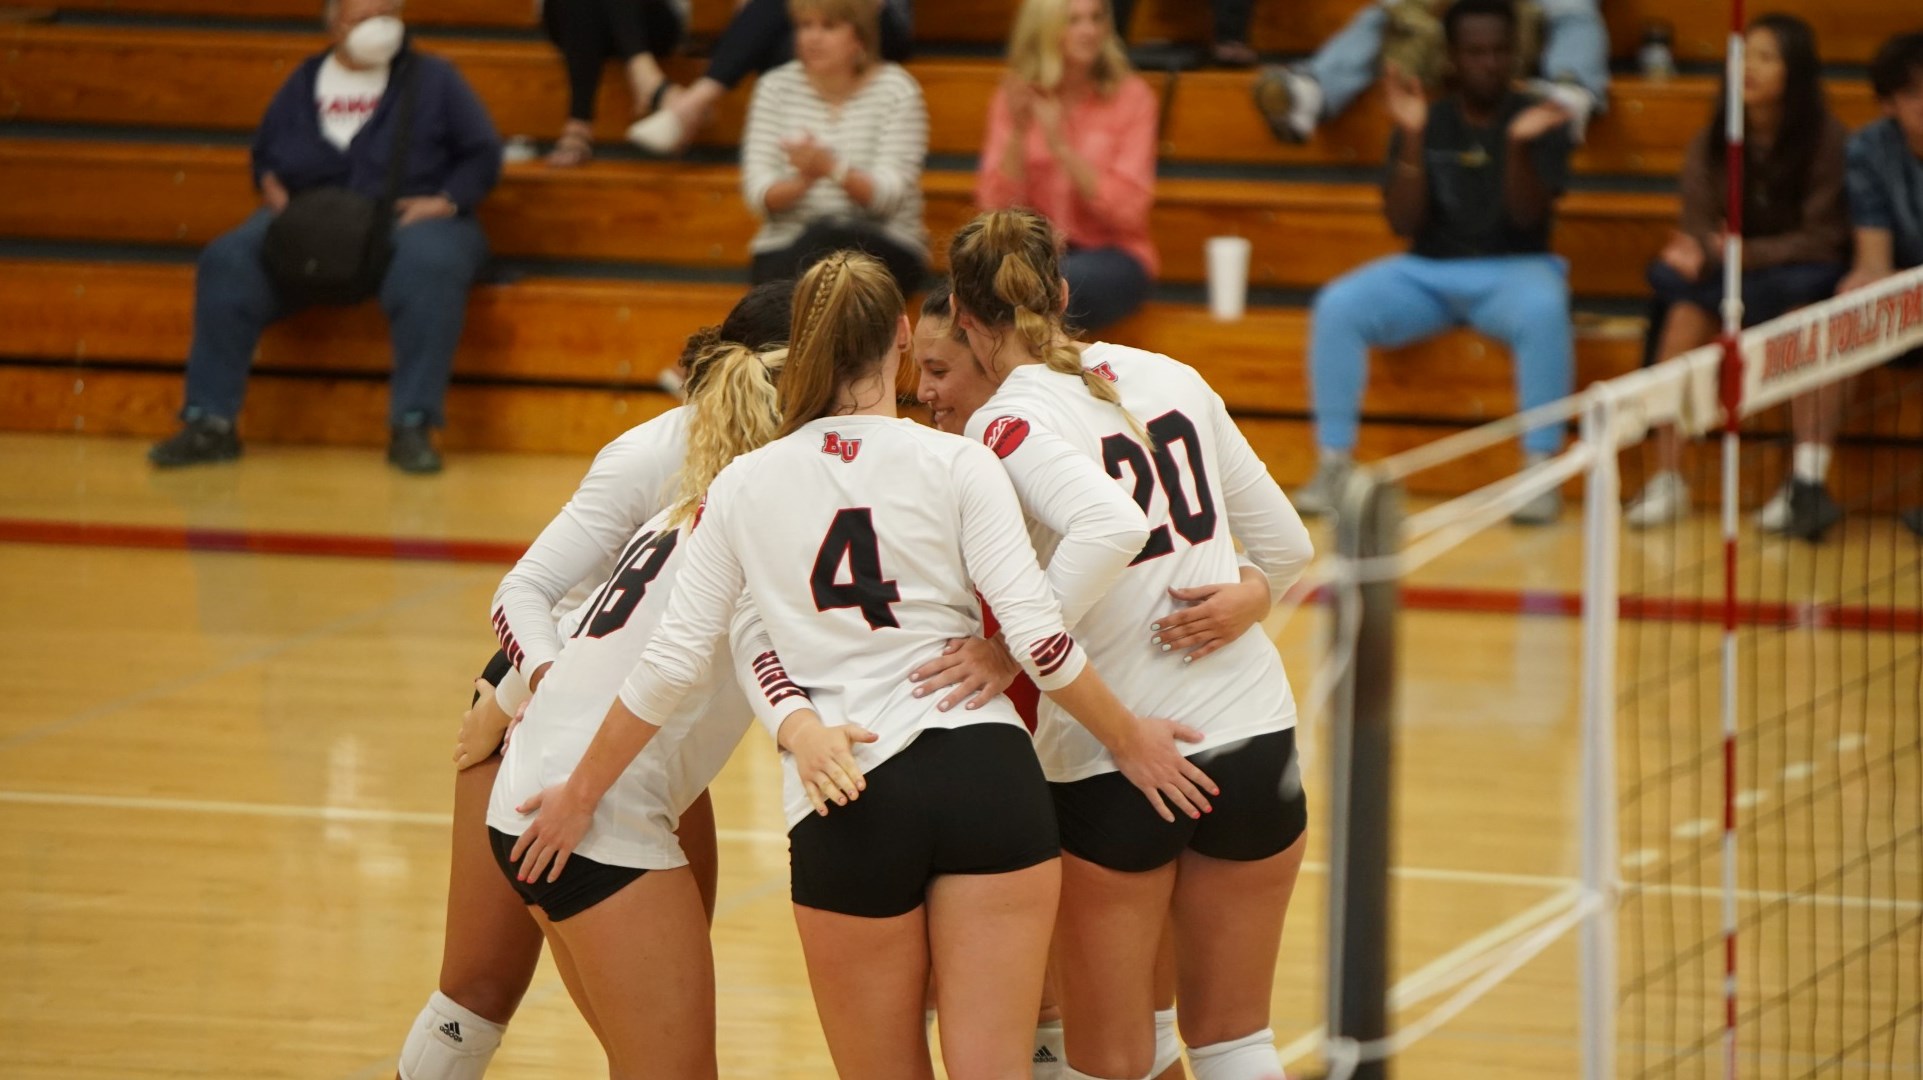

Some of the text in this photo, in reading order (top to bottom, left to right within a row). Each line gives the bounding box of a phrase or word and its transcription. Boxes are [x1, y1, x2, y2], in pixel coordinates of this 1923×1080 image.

[821, 431, 862, 463] BU
[1101, 409, 1217, 568] 20
[570, 528, 680, 639] 18
[810, 507, 901, 631] 4
